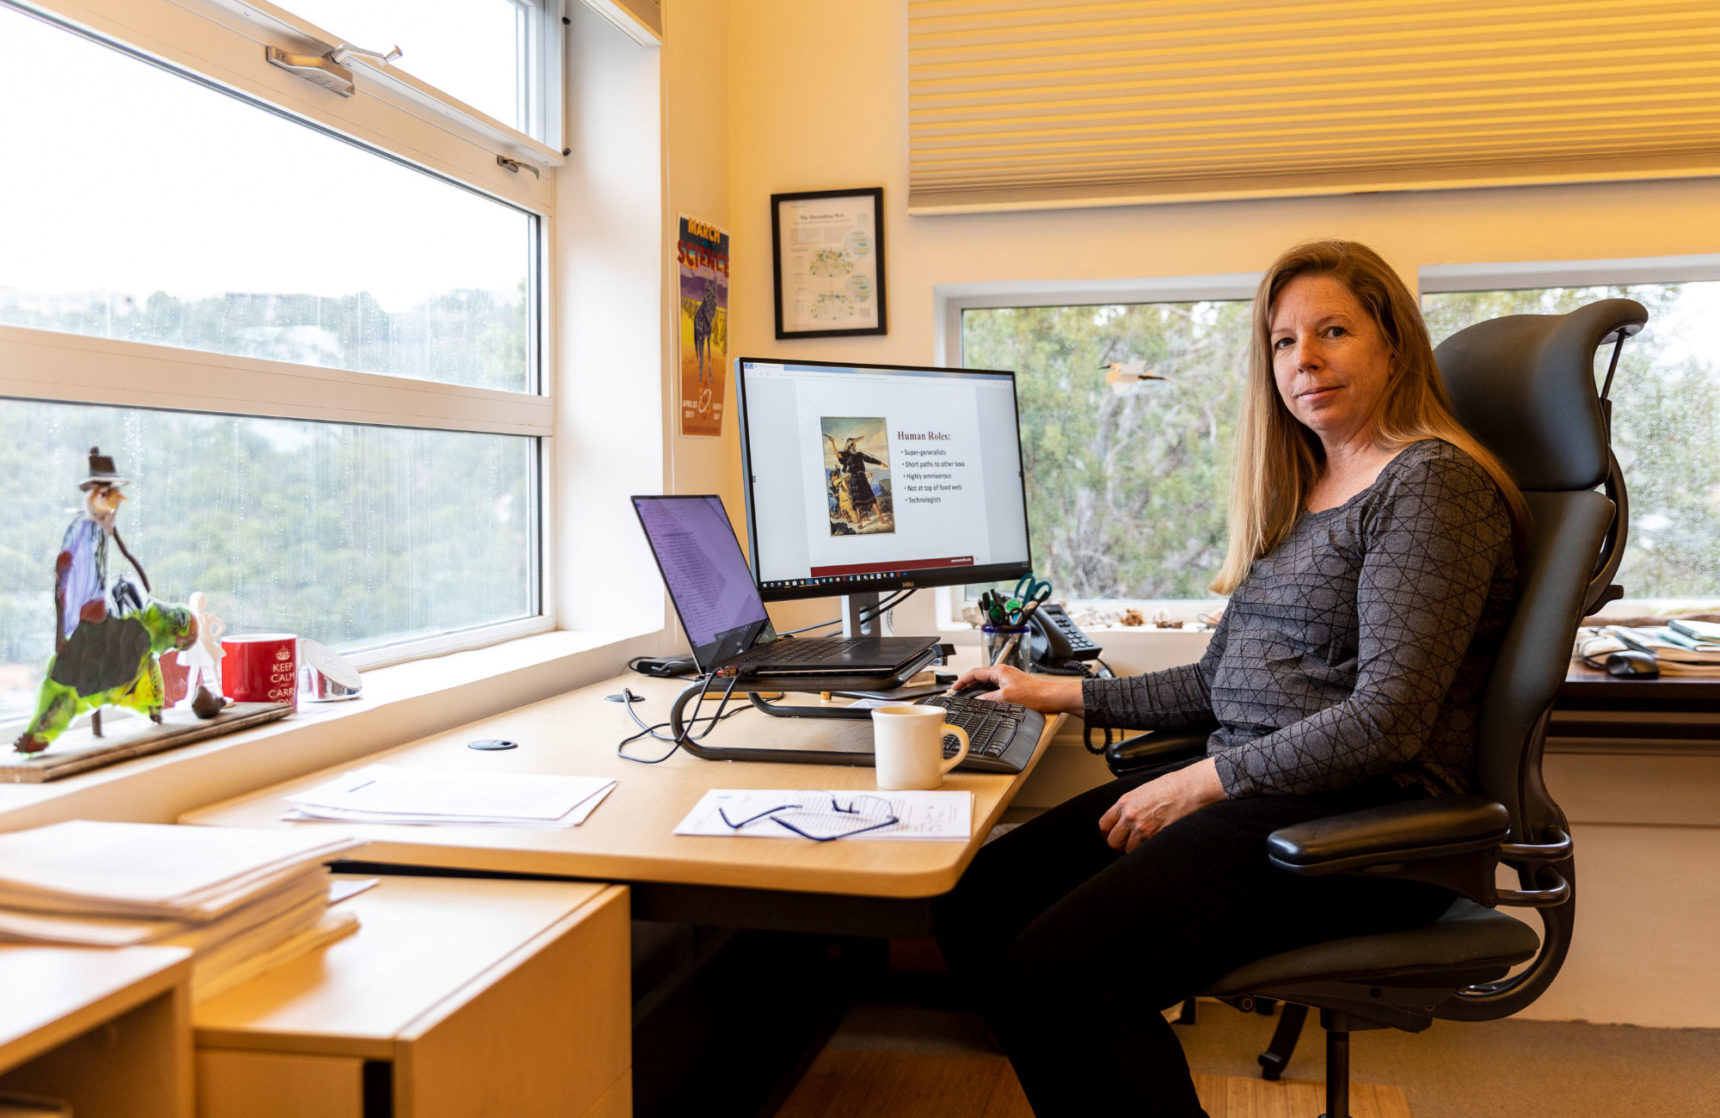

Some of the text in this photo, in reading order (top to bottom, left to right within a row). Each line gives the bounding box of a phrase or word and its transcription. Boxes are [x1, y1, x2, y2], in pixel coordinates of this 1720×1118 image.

[688, 216, 720, 244] MARCH
[678, 238, 729, 278] SCIENCE
[897, 431, 951, 440] Human Roles:
[904, 449, 946, 457] Super-generalists
[920, 461, 933, 469] paths
[906, 473, 922, 481] Highly
[272, 662, 293, 672] KEEP
[270, 672, 295, 683] CALM
